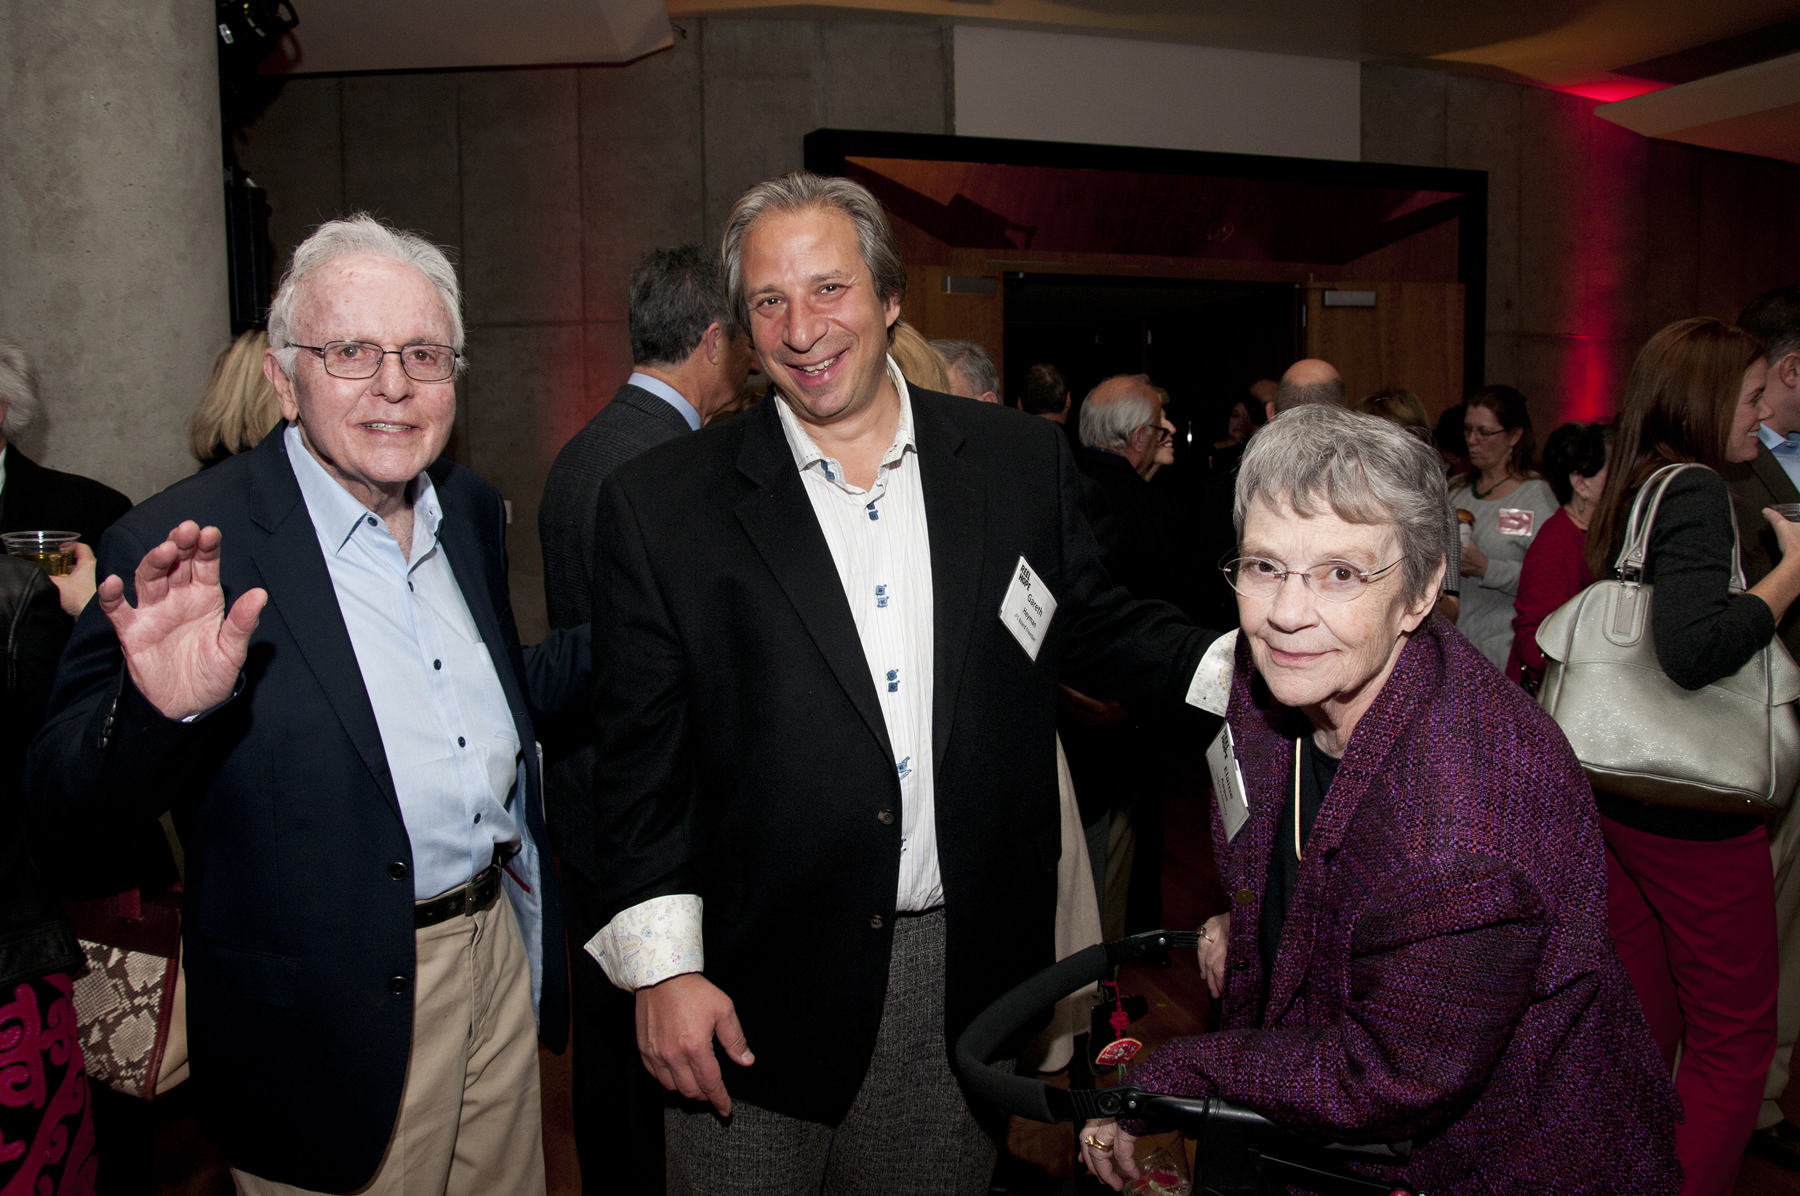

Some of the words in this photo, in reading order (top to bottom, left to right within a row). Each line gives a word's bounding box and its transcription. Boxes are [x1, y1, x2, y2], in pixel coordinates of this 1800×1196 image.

[1018, 573, 1031, 591] HOPE
[1020, 564, 1031, 580] REEL
[1027, 593, 1043, 617] Gareth
[1022, 607, 1037, 628] Heyman
[1223, 766, 1233, 800] Elaine
